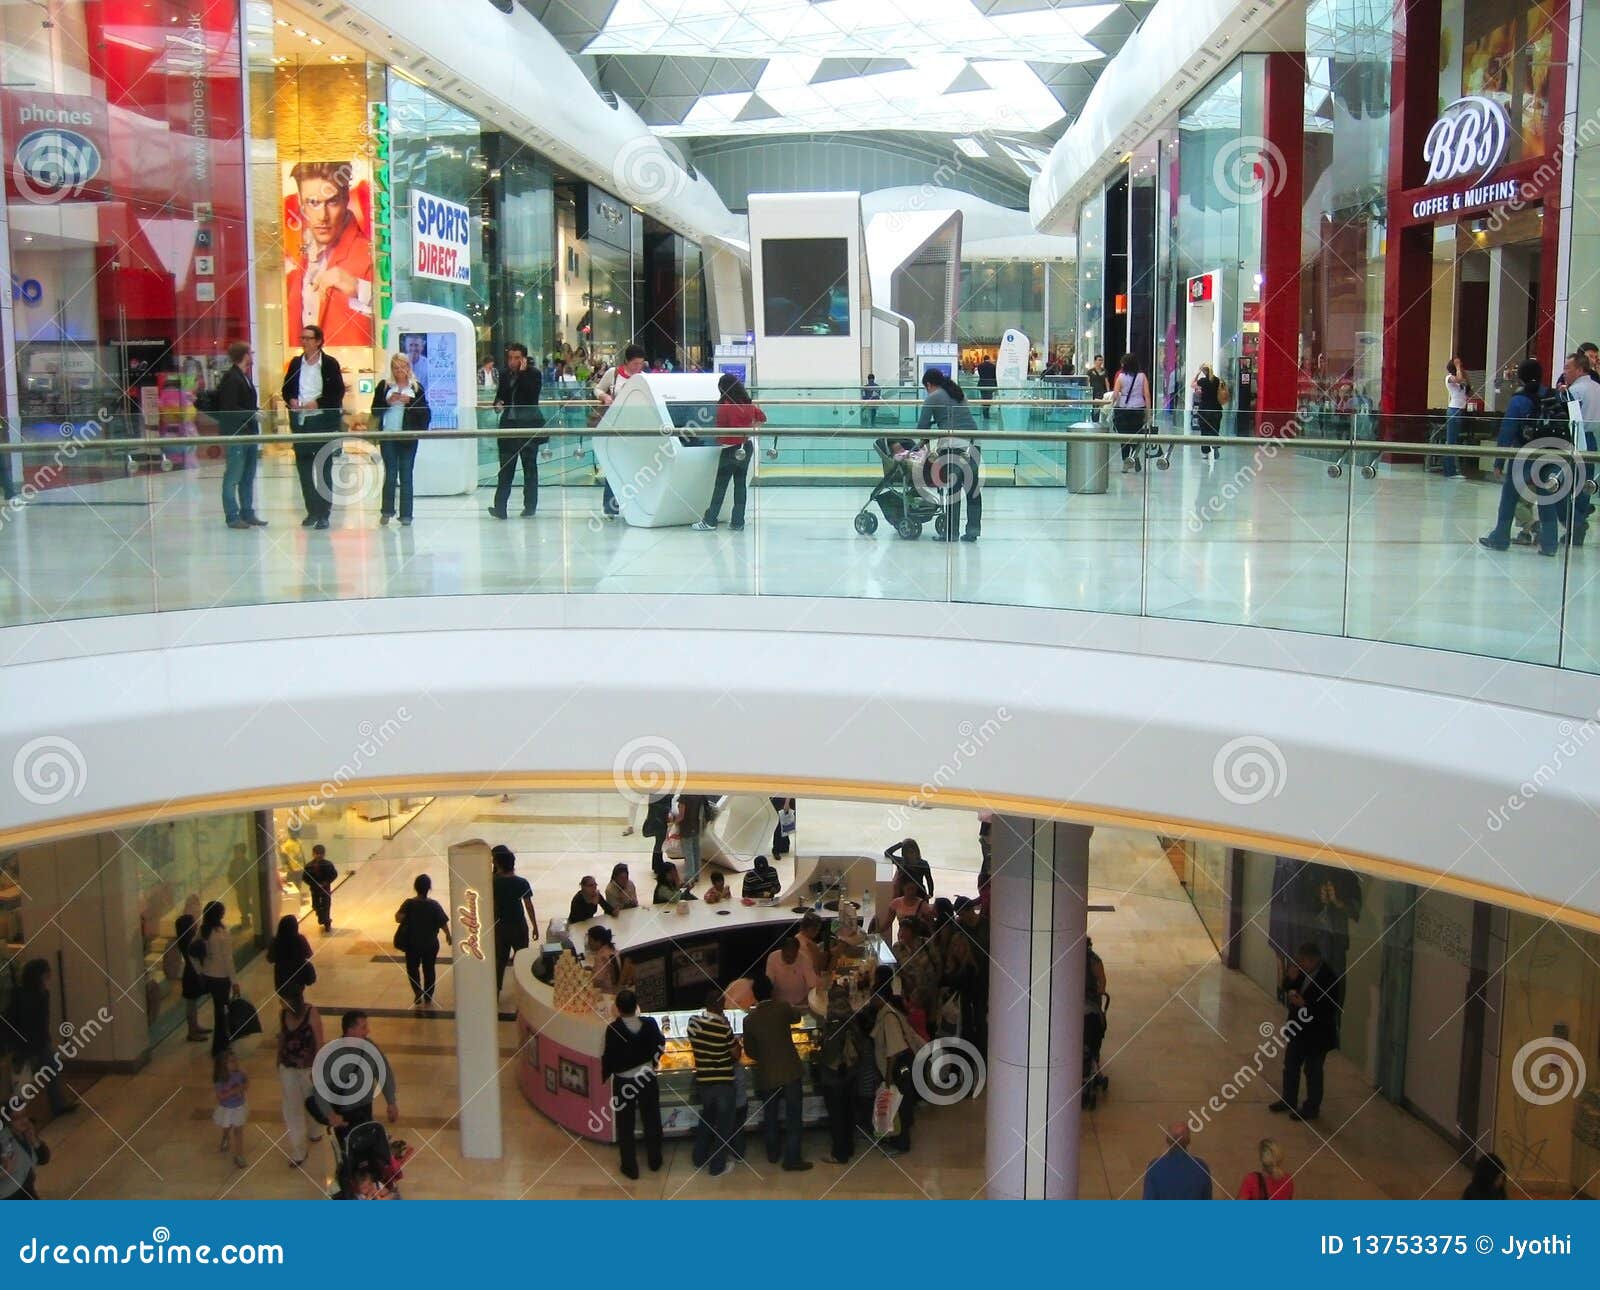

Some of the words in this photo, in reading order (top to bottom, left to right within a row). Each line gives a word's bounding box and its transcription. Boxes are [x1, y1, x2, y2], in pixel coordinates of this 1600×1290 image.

[19, 104, 93, 125] phones
[1412, 195, 1449, 218] COFFEE
[1452, 193, 1460, 210] &
[1464, 179, 1516, 208] MUFFINS
[417, 196, 469, 245] SPORTS
